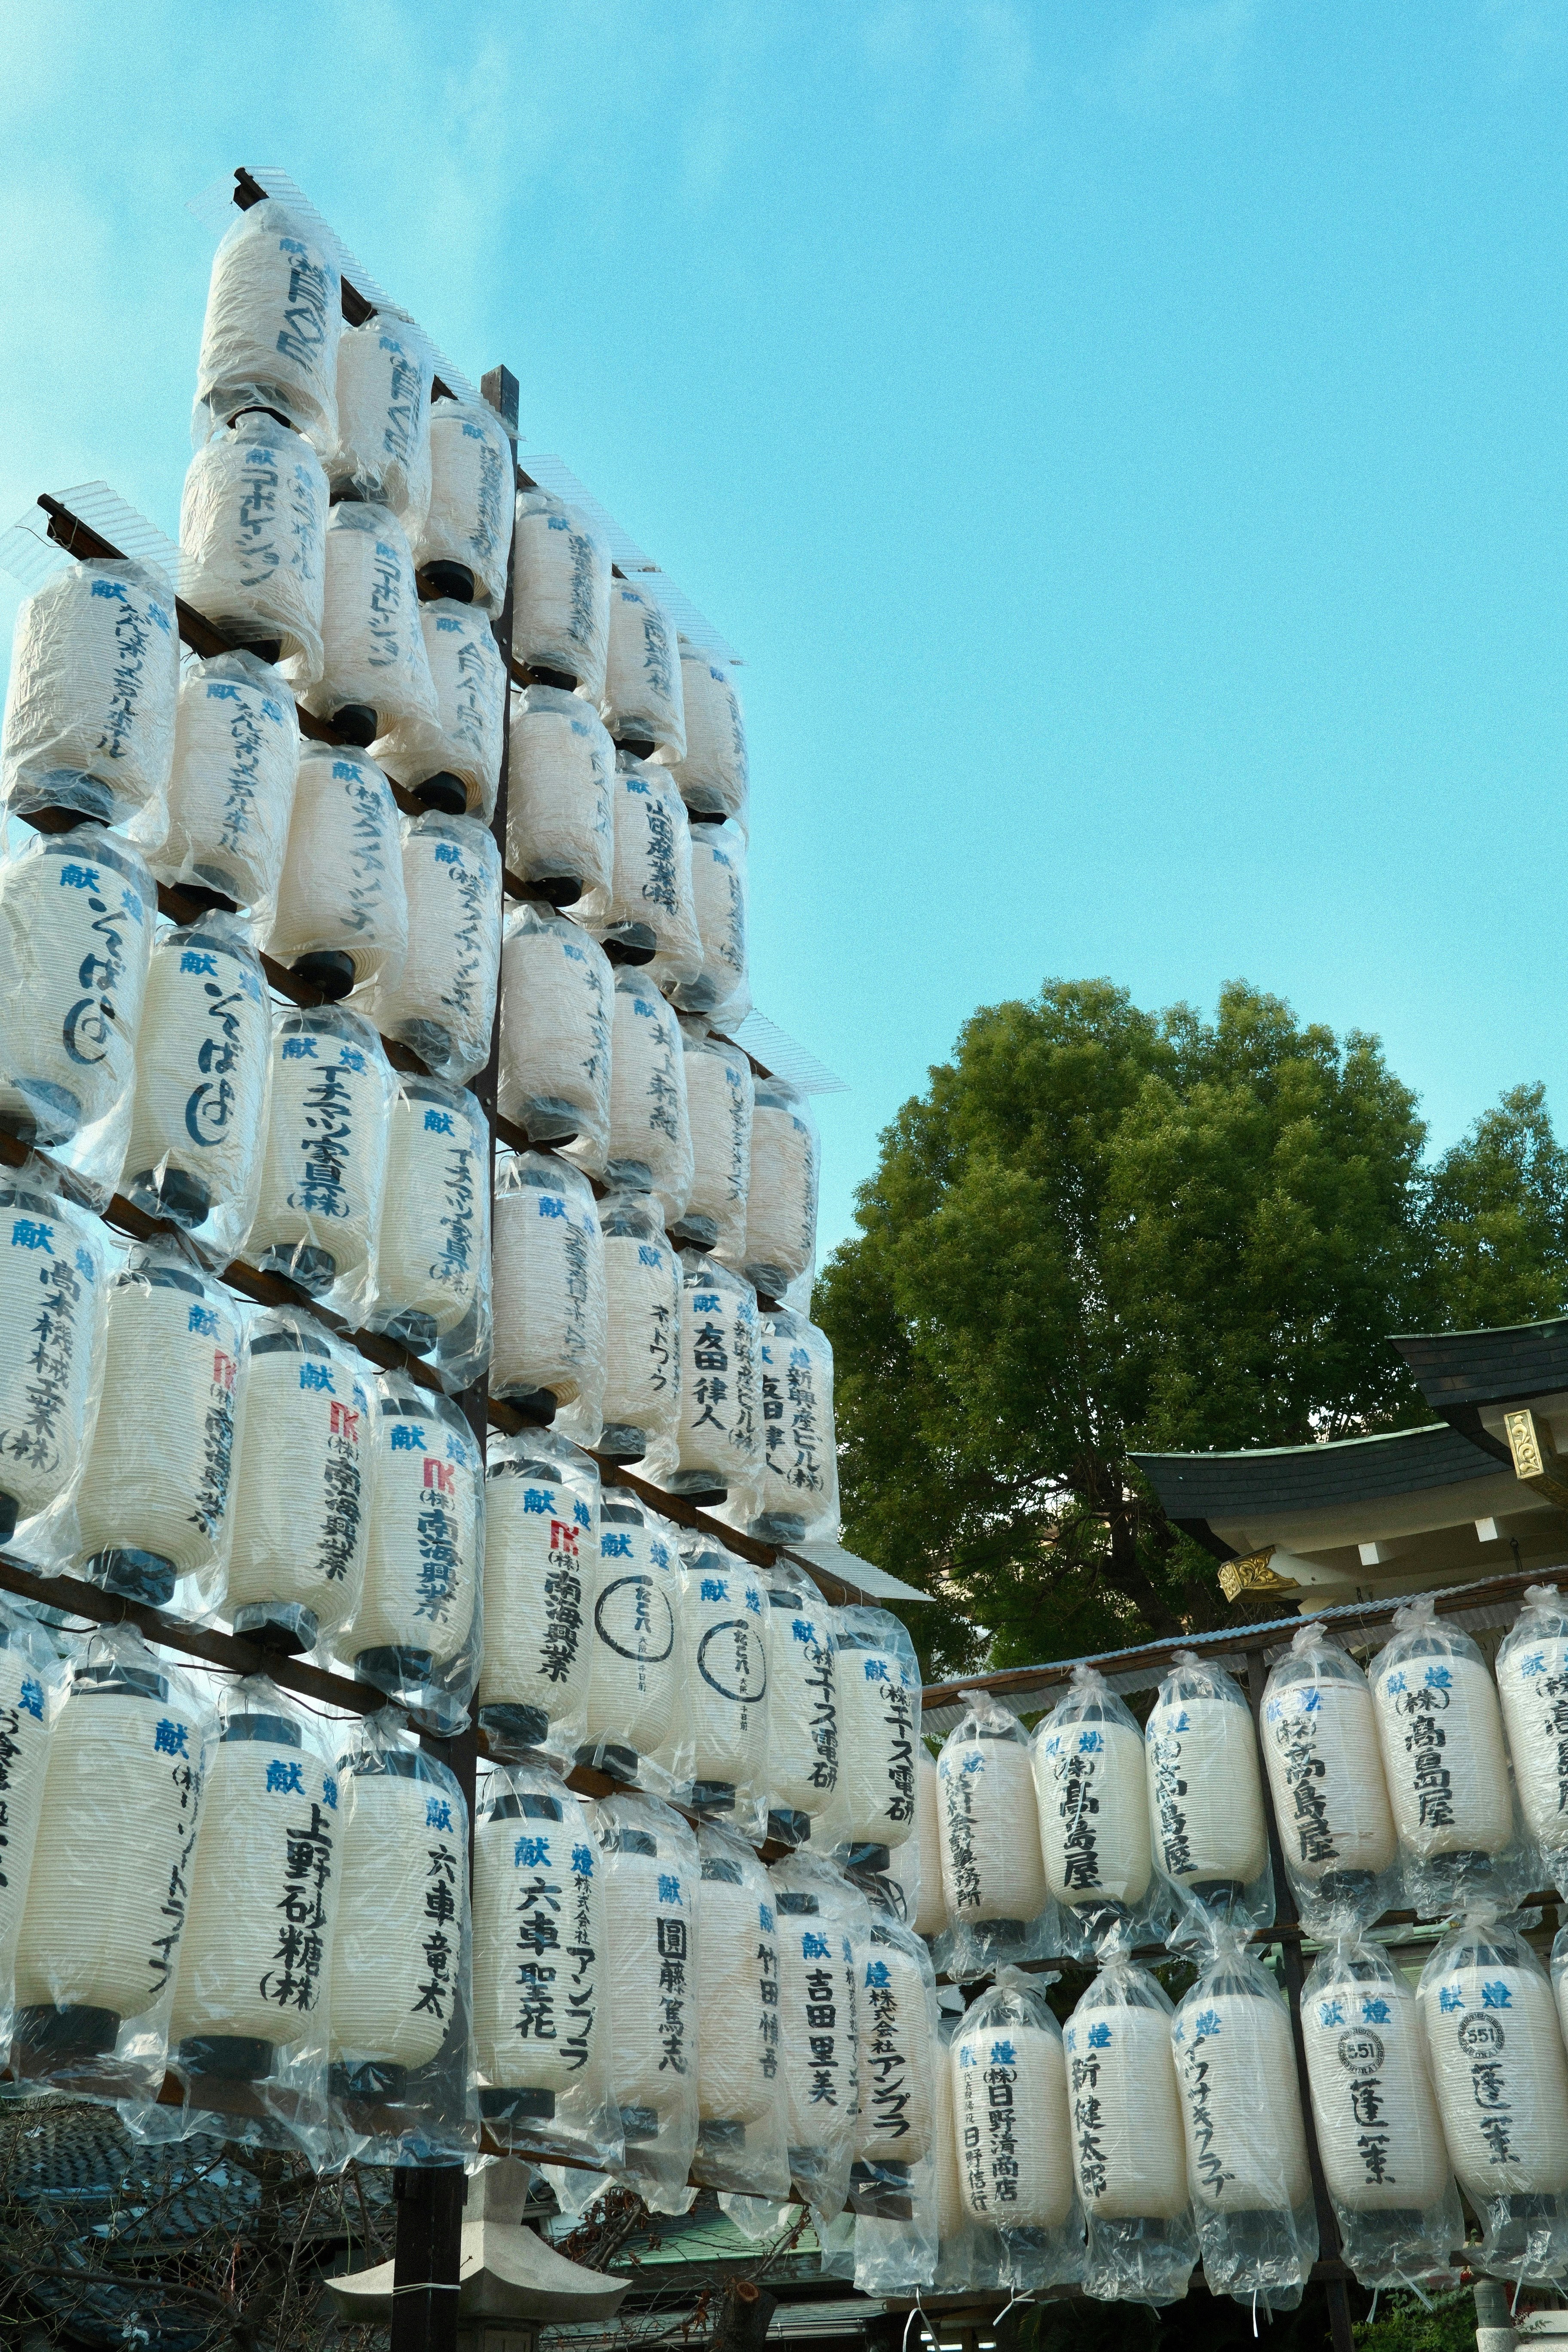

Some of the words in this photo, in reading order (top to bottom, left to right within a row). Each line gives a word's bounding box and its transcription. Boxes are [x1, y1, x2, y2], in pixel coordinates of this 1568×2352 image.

[691, 1321, 729, 1430] 友田律人
[787, 1366, 825, 1492] 新興産ビル(株)
[314, 1434, 361, 1582] (株)南海興業
[413, 1488, 463, 1623] (株)南海興業
[537, 1551, 585, 1683] (株)南海興業
[637, 1664, 647, 1693] 千日前
[740, 1705, 748, 1731] 千日前
[879, 1684, 916, 1825] (株)エース電研
[259, 1802, 333, 2012] 上野砂糖(株)
[411, 1844, 457, 2018] 六車竜太
[511, 1876, 563, 2040] 六車聖花
[805, 1969, 839, 2107] 吉田里美
[867, 1989, 911, 2139] 株式会社アンプラ
[1347, 2043, 1375, 2059] 551
[1467, 2028, 1494, 2044] 551
[964, 2125, 989, 2212] 日野信行
[983, 2067, 1018, 2203] (株)日野清商店
[1072, 2052, 1108, 2198] 新健太郎
